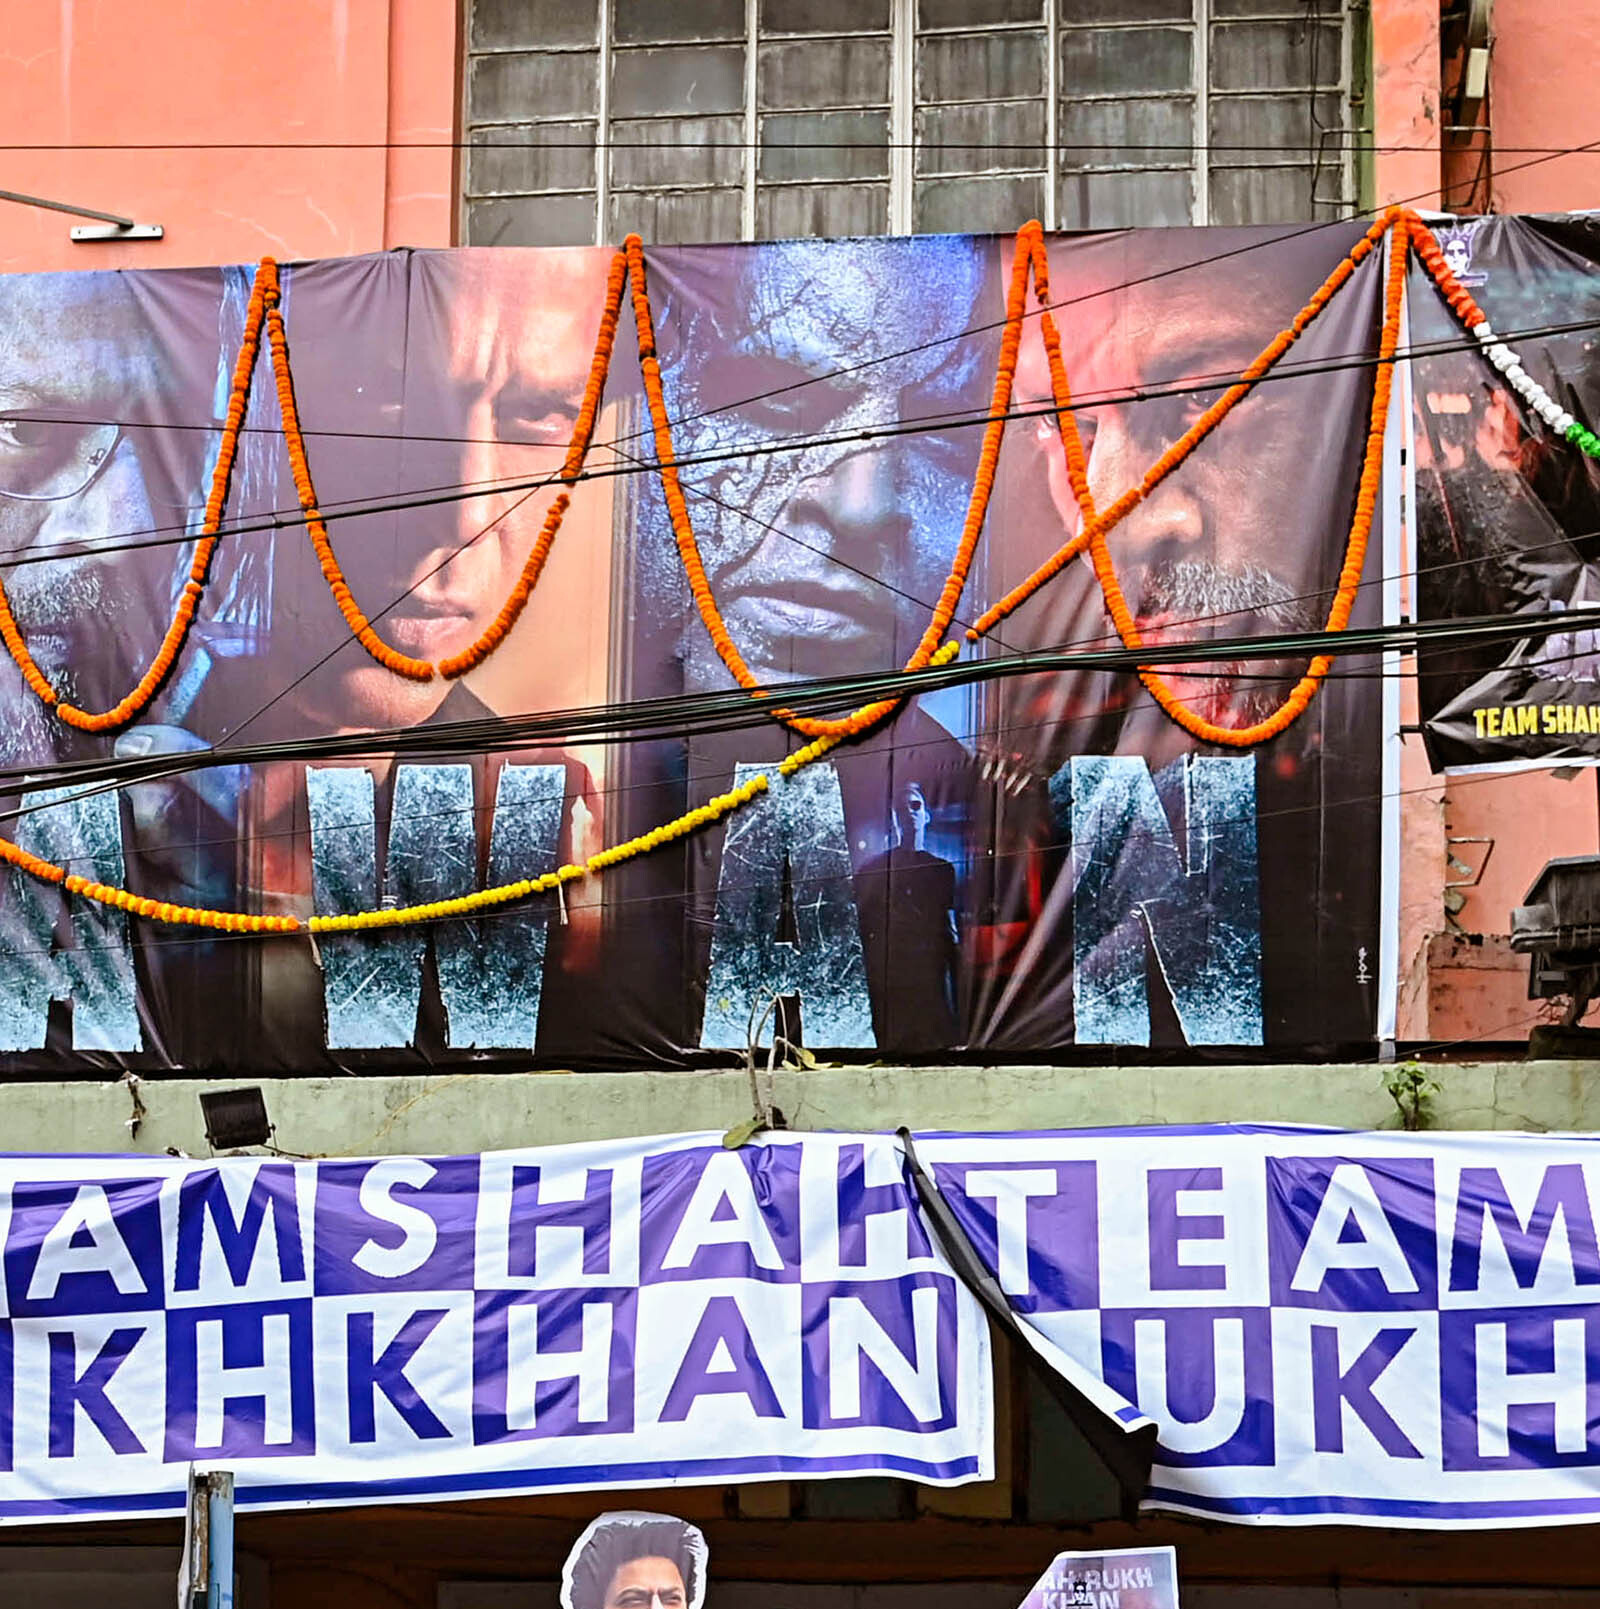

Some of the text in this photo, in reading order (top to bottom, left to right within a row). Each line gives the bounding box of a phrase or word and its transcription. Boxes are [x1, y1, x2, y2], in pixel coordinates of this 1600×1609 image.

[1473, 704, 1539, 739] TEAM
[1138, 1316, 1590, 1458] UKH
[1083, 1566, 1154, 1592] RUKH
